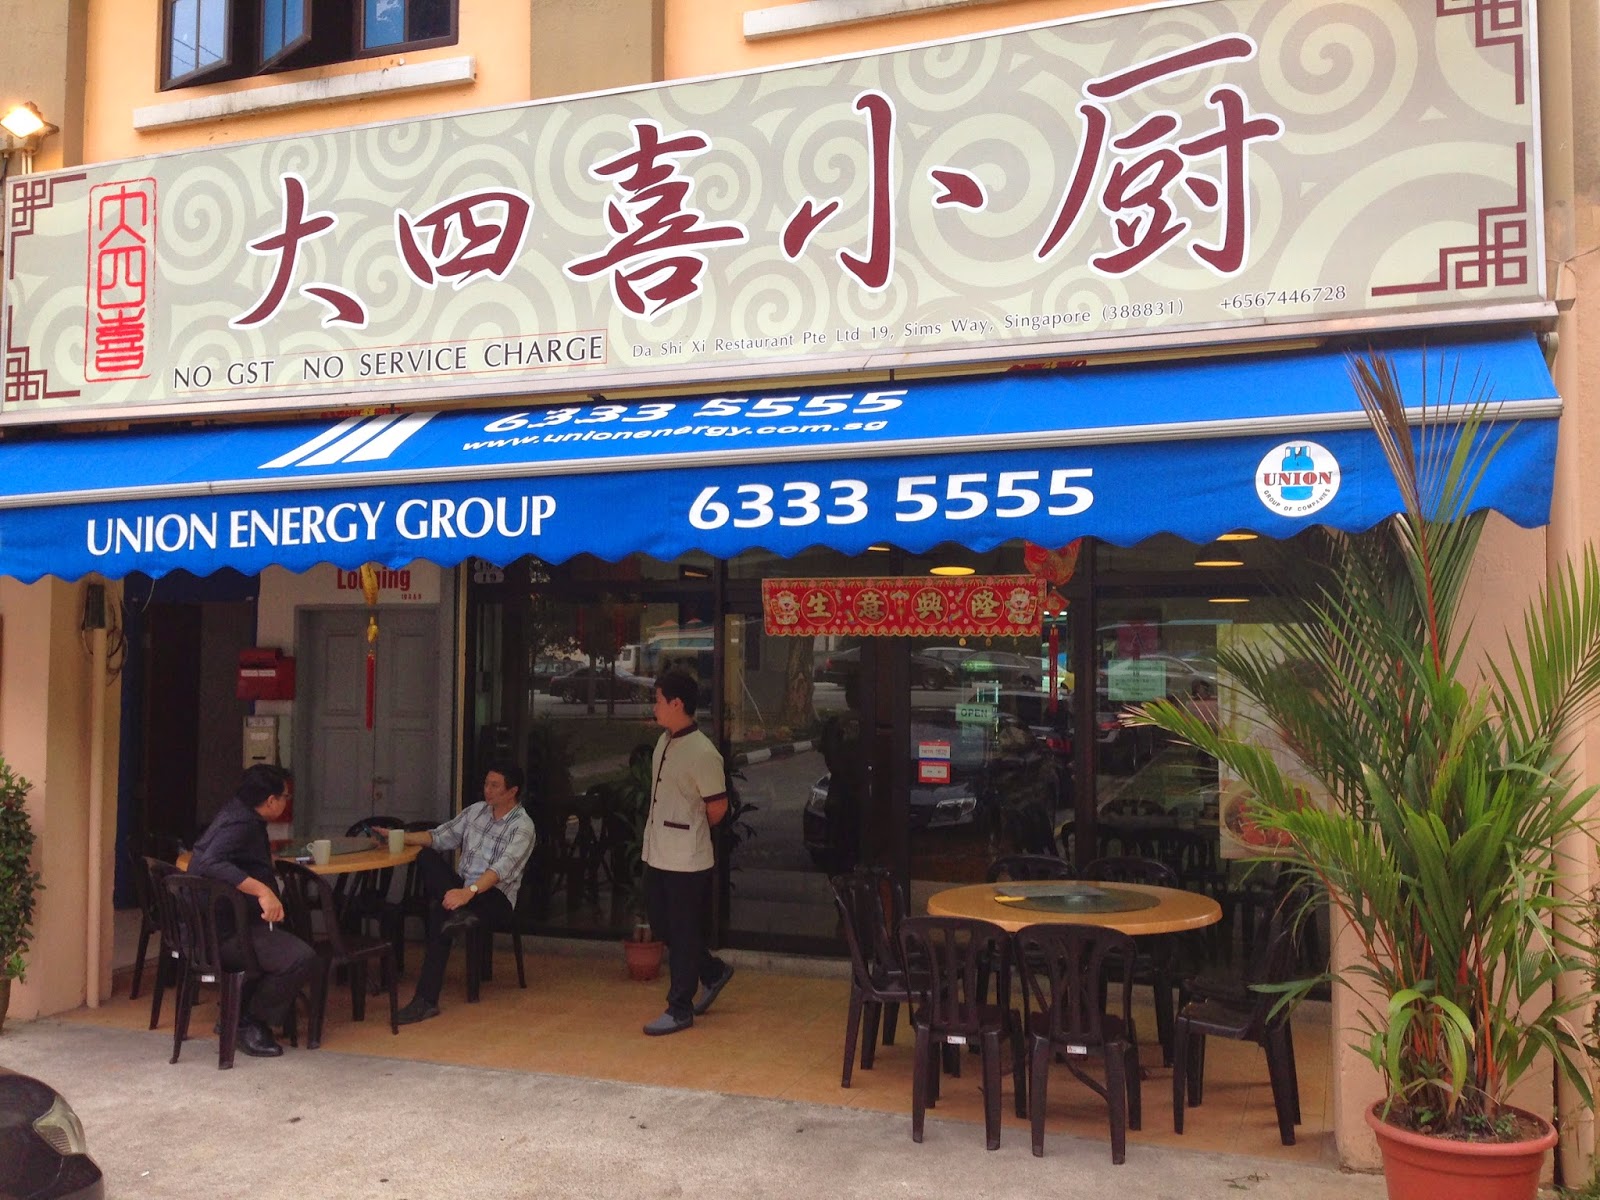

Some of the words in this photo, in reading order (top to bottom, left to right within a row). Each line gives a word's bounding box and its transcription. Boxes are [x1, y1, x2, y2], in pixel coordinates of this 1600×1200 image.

[235, 37, 1282, 325] 大四喜小厨
[1220, 285, 1346, 311] +6567446728
[632, 345, 651, 358] Da
[660, 341, 683, 356] Shi
[692, 341, 706, 353] Xi
[715, 335, 793, 350] Restaurant
[803, 331, 827, 344] Pte
[836, 328, 859, 342] Ltd
[870, 326, 895, 341] 19,
[904, 323, 942, 338] Sims
[951, 318, 994, 334] Way,
[1004, 310, 1091, 332] Singapore
[1102, 299, 1184, 320] (388831)
[174, 366, 212, 388] NO
[227, 361, 274, 385] GST
[303, 356, 344, 380] NO
[359, 346, 468, 376] SERVICE
[484, 336, 603, 367] CHARGE
[484, 403, 677, 433] 6333
[693, 390, 909, 418] 5555
[462, 418, 888, 452] www.unionenergy.com.sg
[1263, 471, 1333, 486] UNION
[688, 480, 869, 531] 6333
[895, 468, 1095, 523] 5555
[86, 512, 219, 555] UNION
[230, 501, 386, 549] ENERGY
[394, 495, 557, 541] GROUP
[337, 567, 411, 592] Loing
[806, 590, 1001, 620] 生意興隆
[960, 708, 988, 718] OPEN
